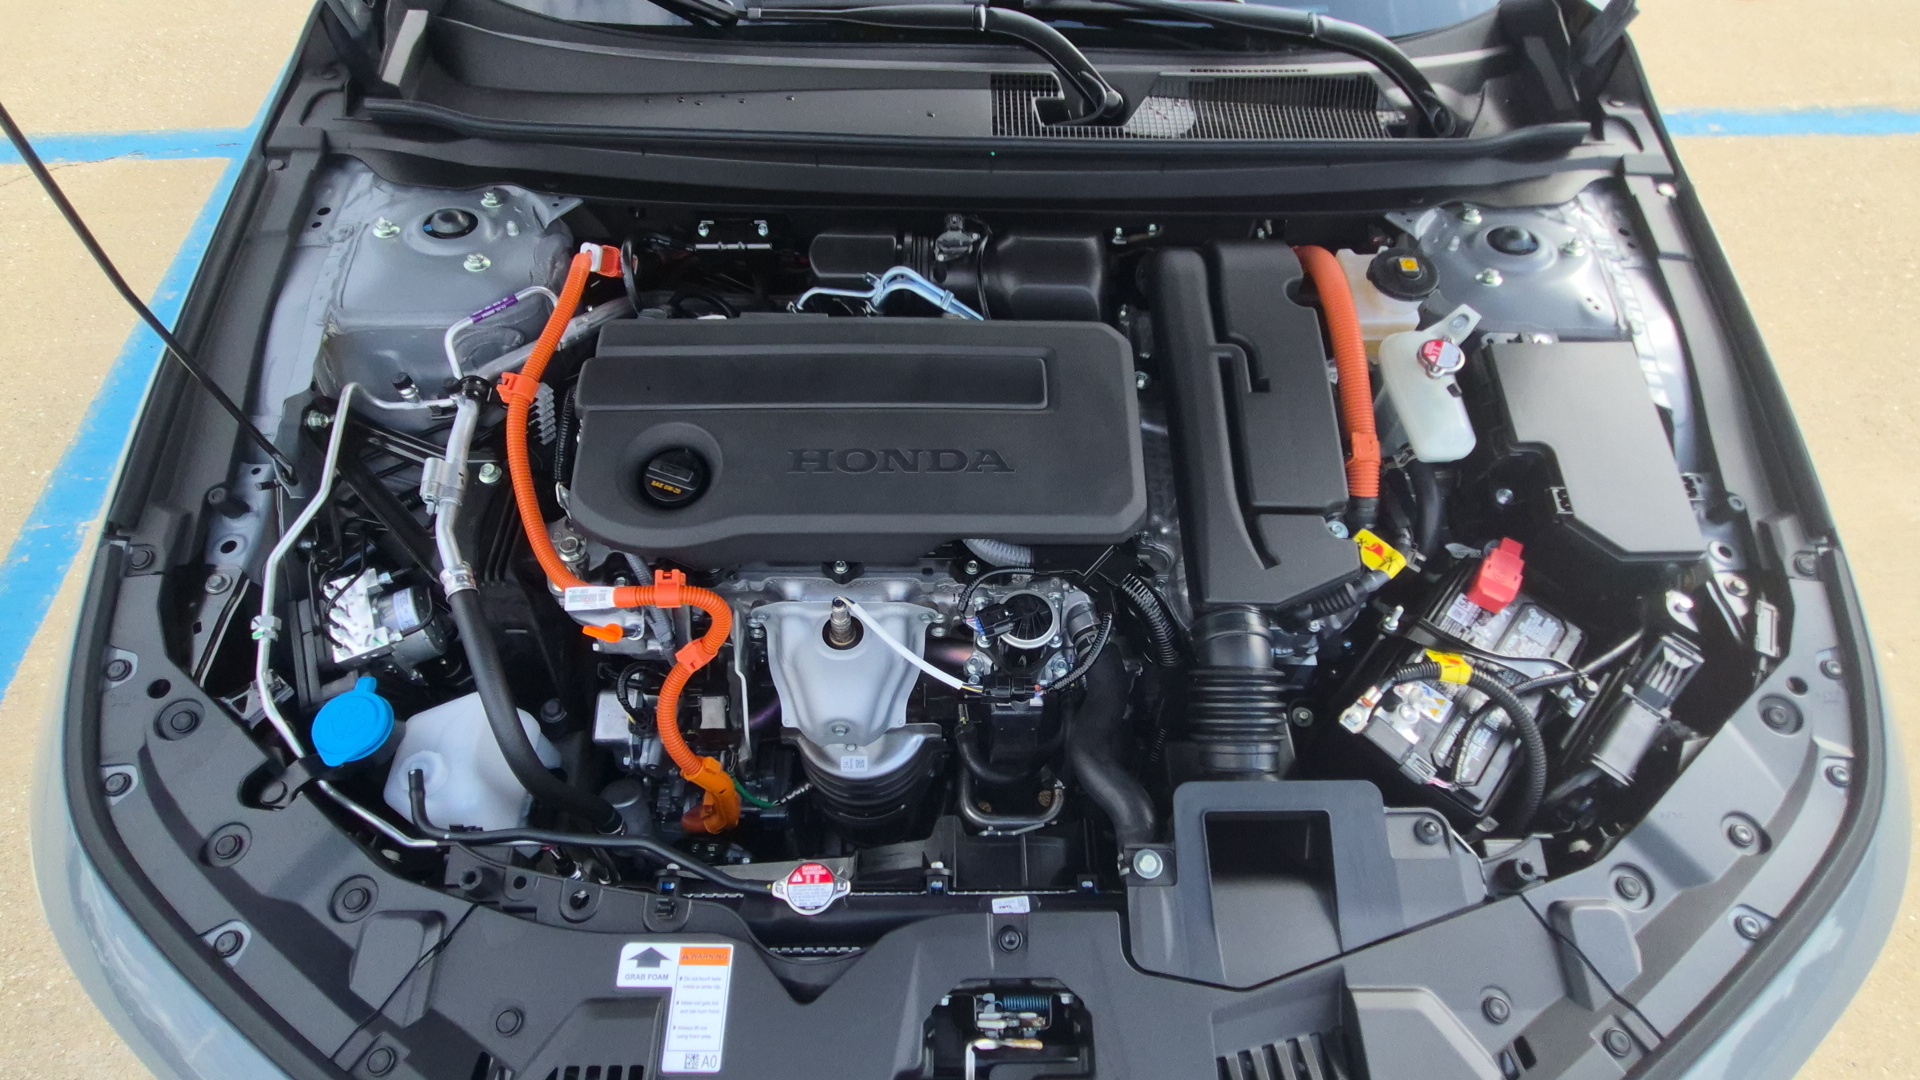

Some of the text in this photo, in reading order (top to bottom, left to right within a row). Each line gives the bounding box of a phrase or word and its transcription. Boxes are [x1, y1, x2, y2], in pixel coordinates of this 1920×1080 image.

[787, 449, 1016, 474] HONDA
[624, 973, 669, 981] GRAB FOAM
